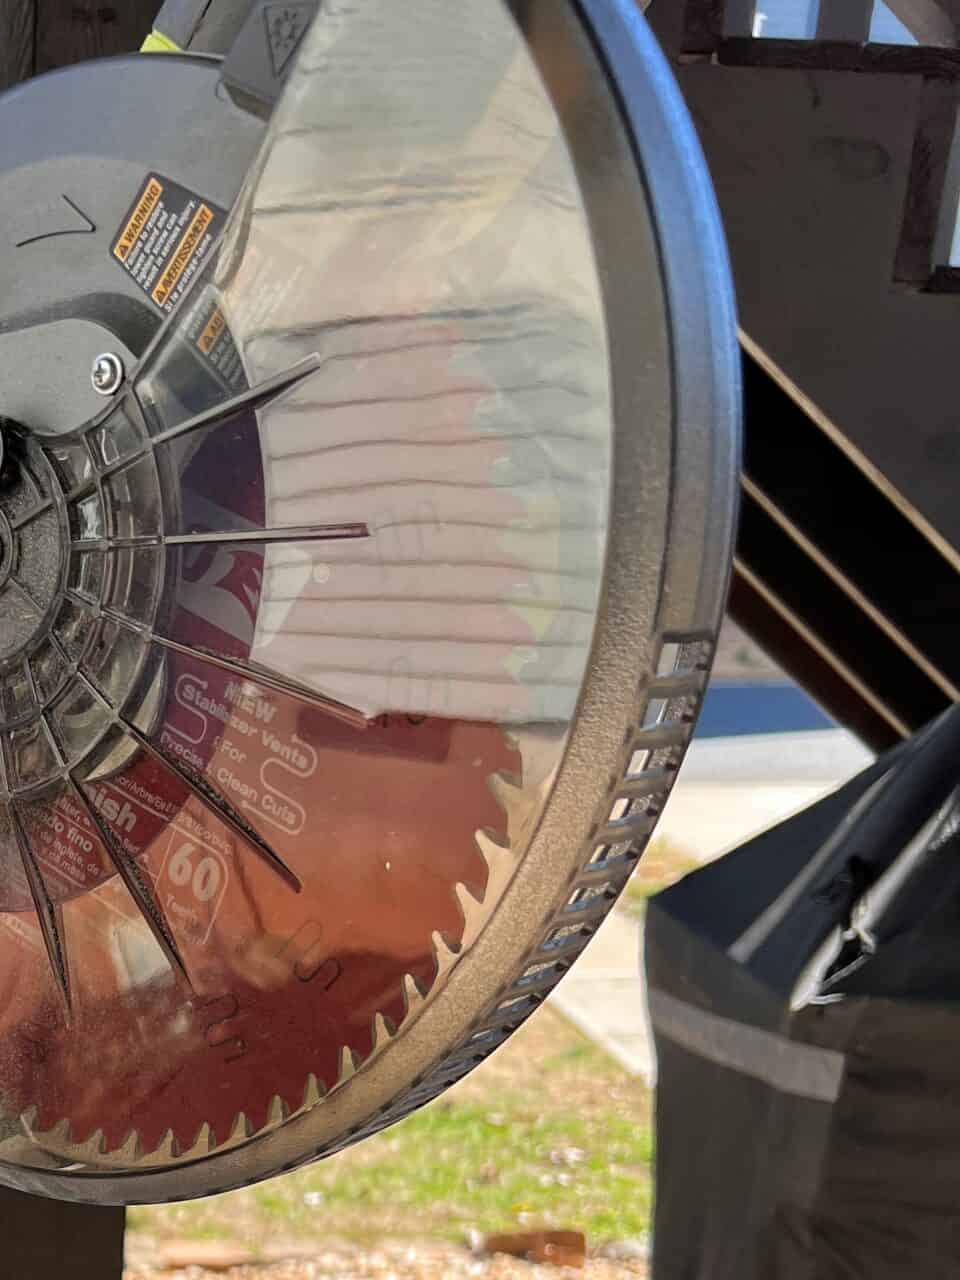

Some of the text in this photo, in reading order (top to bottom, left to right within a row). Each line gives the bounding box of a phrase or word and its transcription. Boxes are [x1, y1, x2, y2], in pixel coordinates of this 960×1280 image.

[124, 184, 159, 243] WARNING
[163, 209, 211, 294] AVERTISSEMENT
[221, 739, 247, 763] For
[261, 730, 309, 769] Vents
[217, 767, 258, 802] Clean
[262, 795, 297, 825] Cuts
[66, 824, 94, 853] fino
[168, 842, 221, 902] 60
